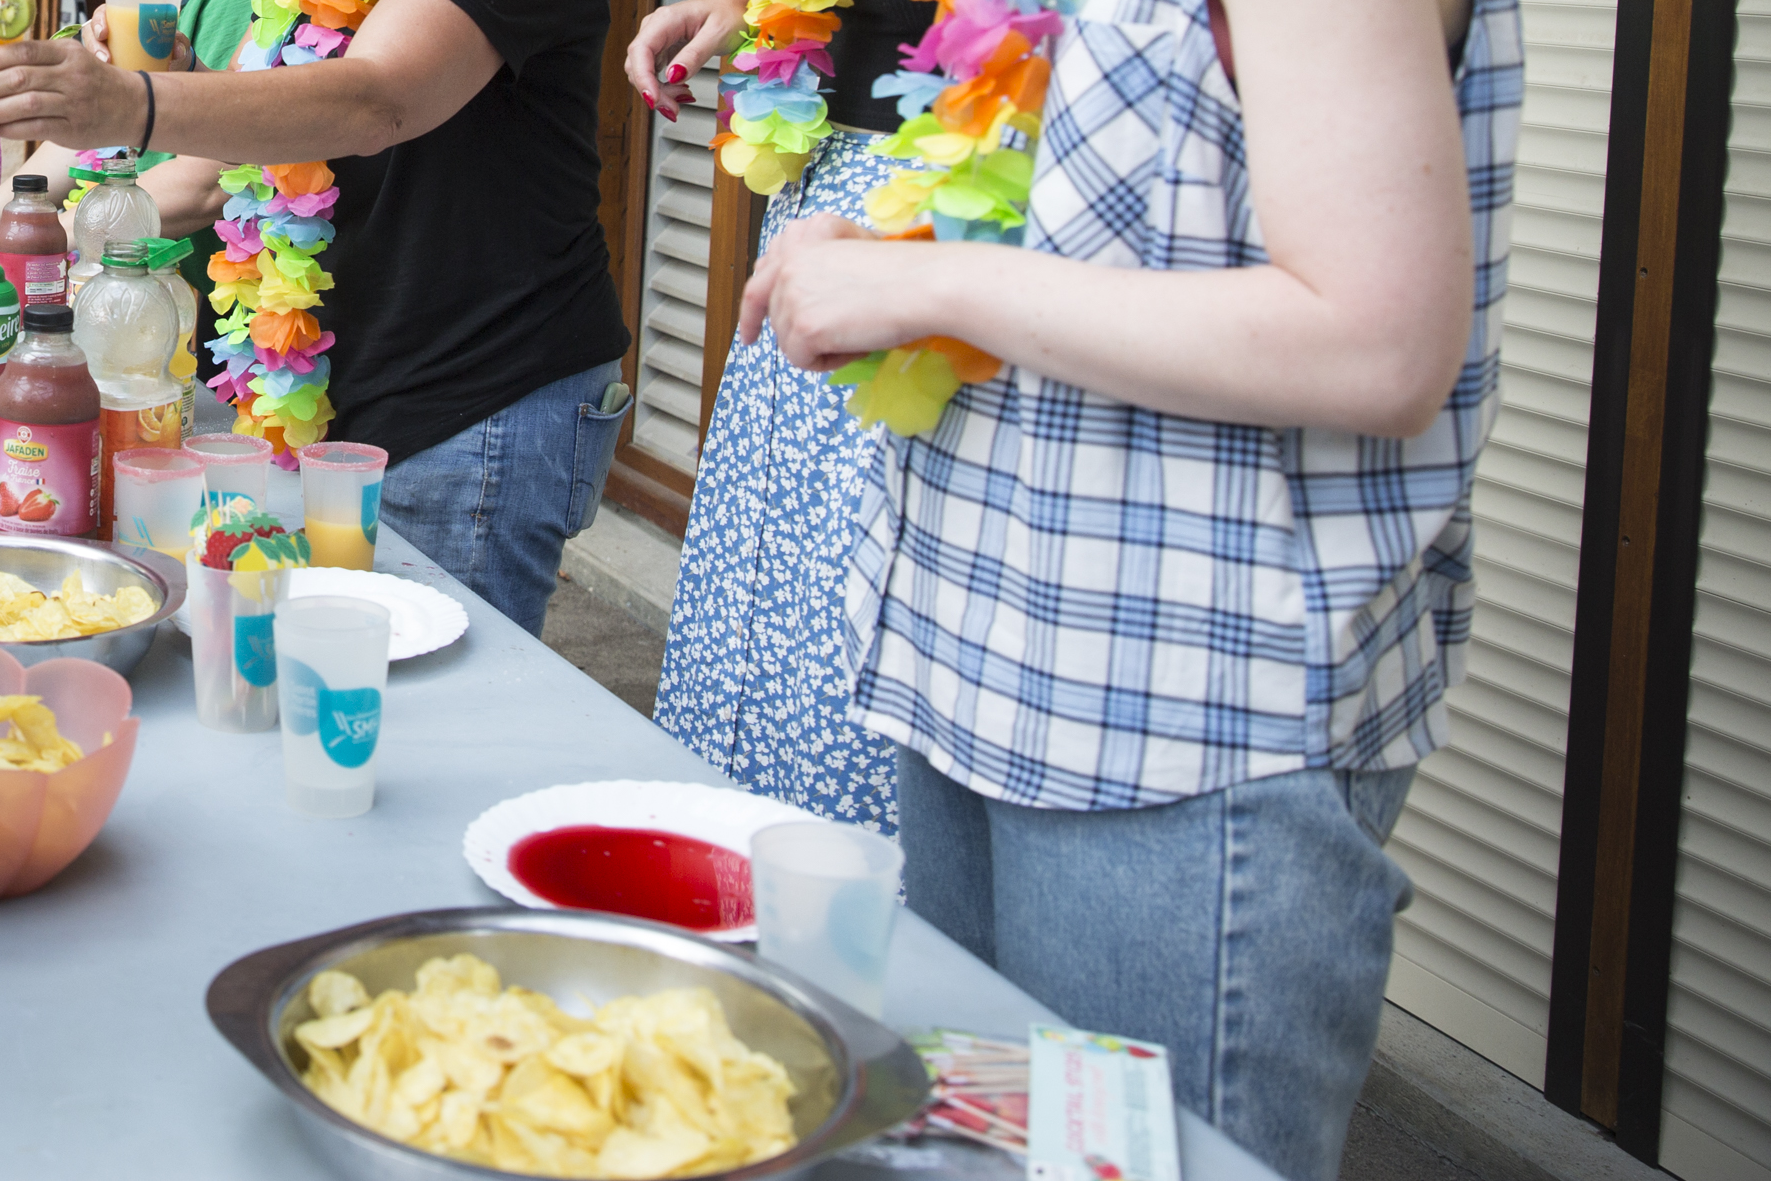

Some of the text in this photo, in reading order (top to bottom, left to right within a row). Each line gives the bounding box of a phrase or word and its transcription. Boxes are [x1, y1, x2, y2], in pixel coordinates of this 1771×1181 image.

[5, 442, 45, 457] JAFADEN
[7, 459, 40, 478] Fraise
[10, 473, 36, 486] France
